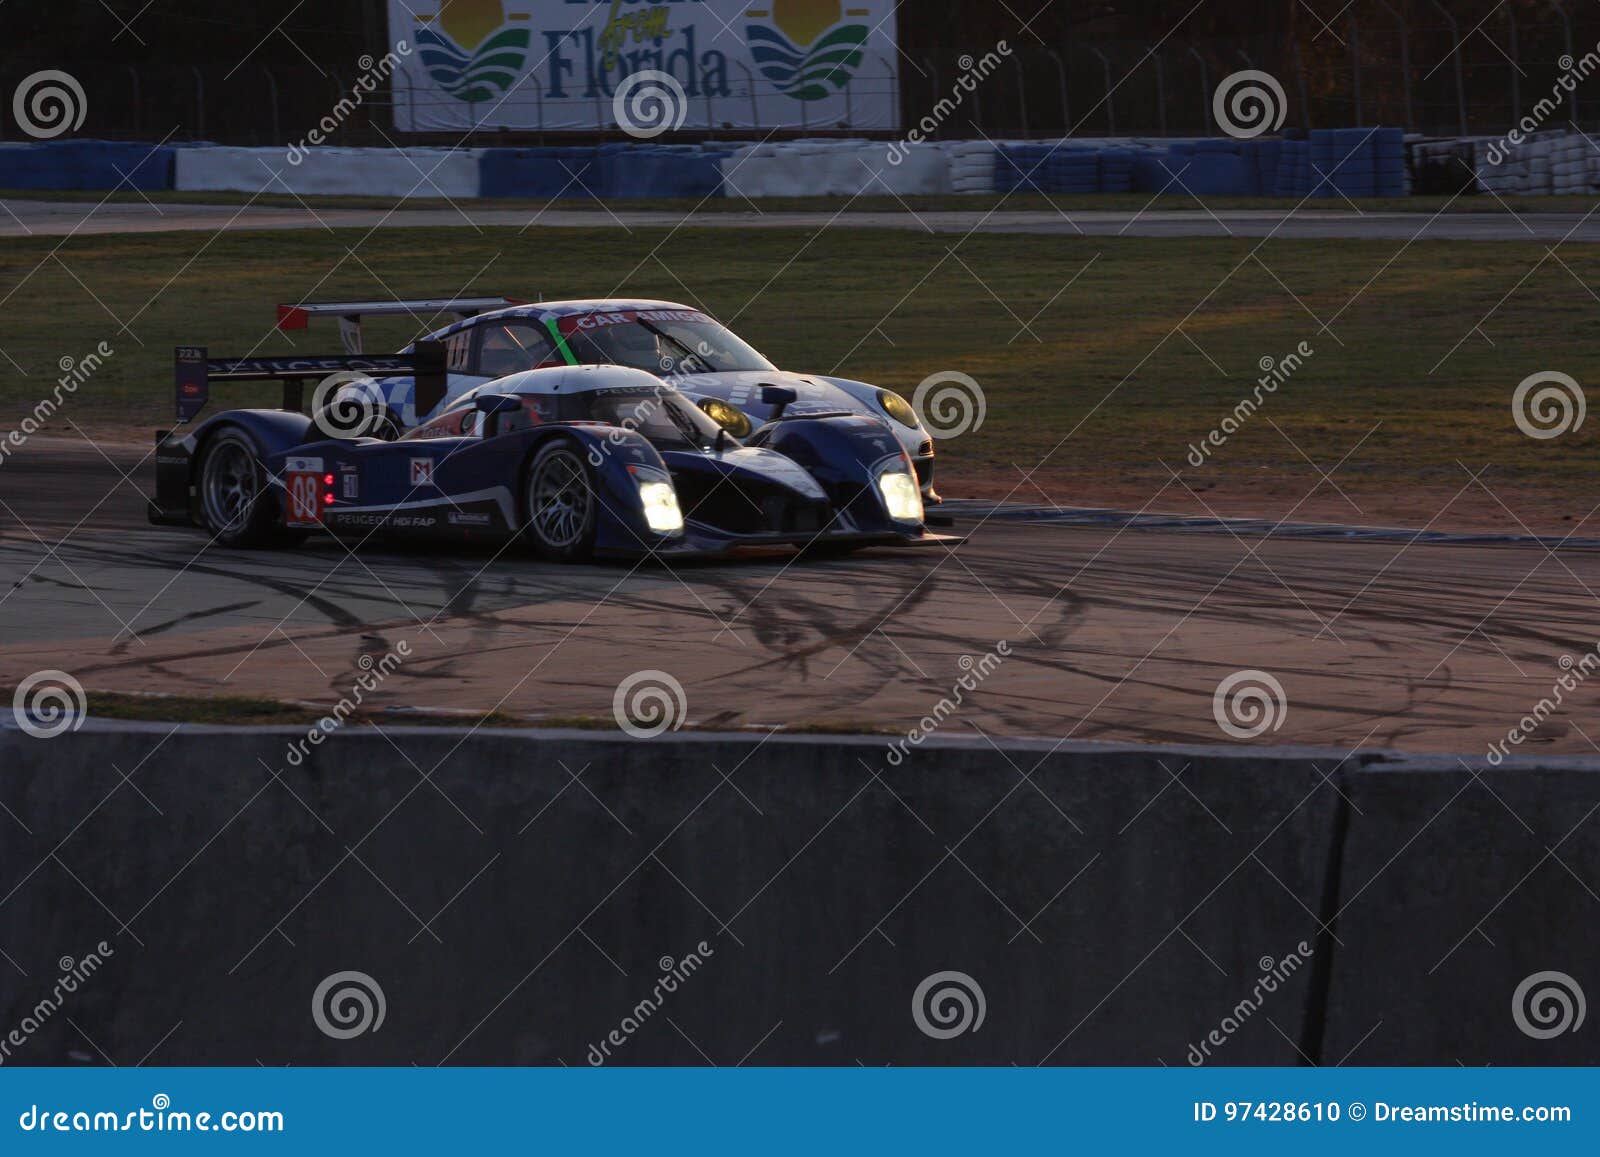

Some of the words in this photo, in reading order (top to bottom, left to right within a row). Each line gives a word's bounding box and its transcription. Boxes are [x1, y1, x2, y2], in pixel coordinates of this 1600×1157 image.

[542, 25, 731, 98] Florida
[577, 315, 629, 329] CAR
[337, 514, 391, 526] PEUGEOT
